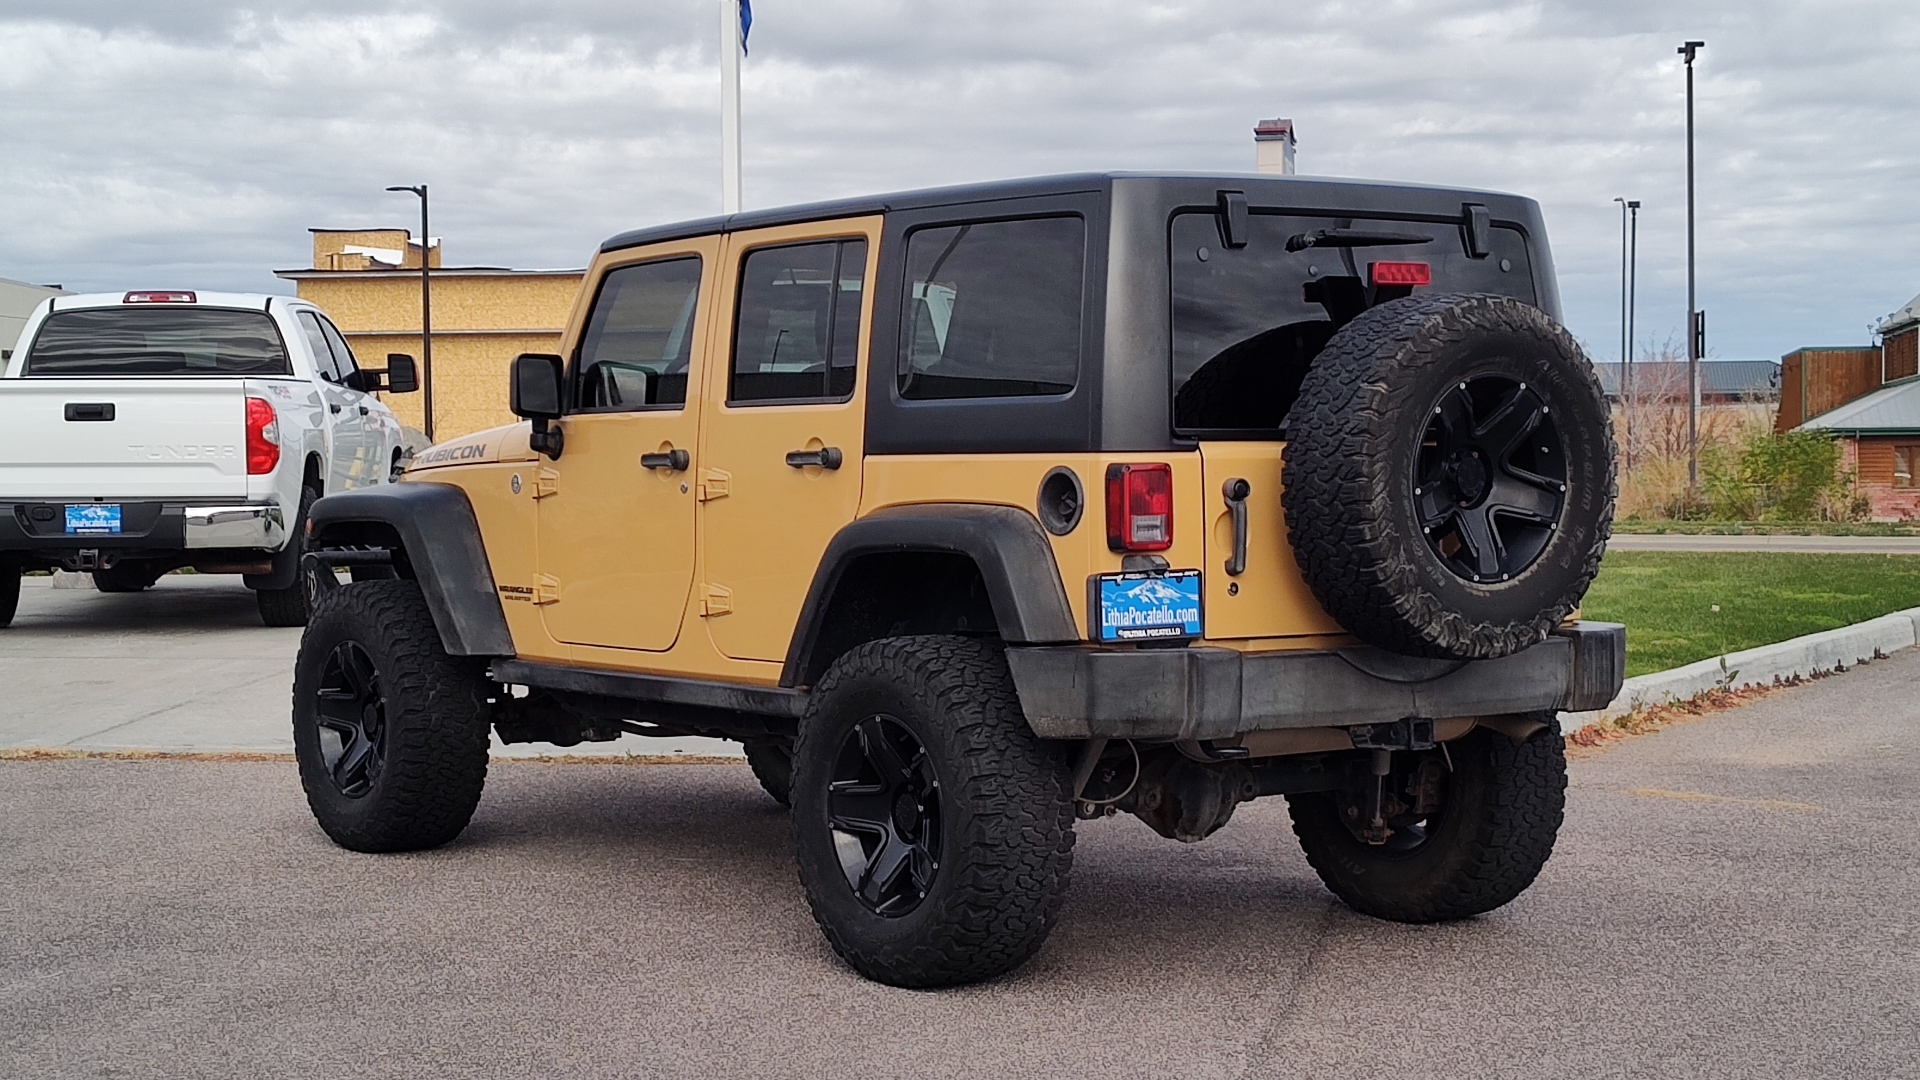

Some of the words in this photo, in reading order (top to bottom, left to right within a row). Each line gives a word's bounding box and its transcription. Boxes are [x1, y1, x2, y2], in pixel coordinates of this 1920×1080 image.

[127, 445, 238, 459] TUNDRA
[417, 444, 487, 464] RUBICON
[1102, 605, 1198, 626] LithiaPocatello.com
